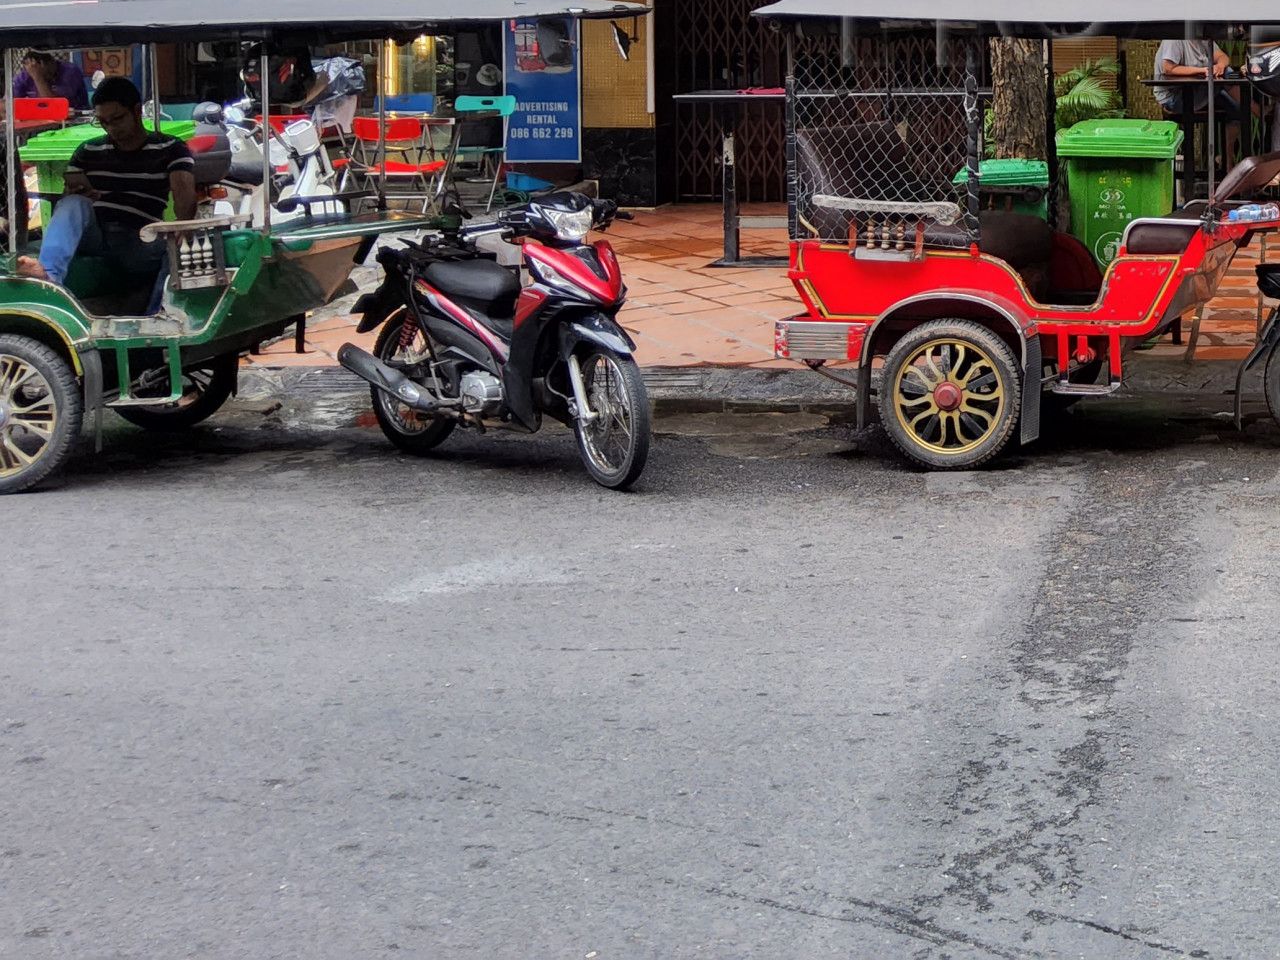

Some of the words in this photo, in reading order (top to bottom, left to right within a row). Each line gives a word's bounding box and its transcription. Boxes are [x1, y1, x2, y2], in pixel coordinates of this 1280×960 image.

[514, 101, 569, 112] ADVERTISING
[526, 115, 558, 125] RENTAL
[510, 128, 530, 139] 086
[554, 128, 574, 139] 299
